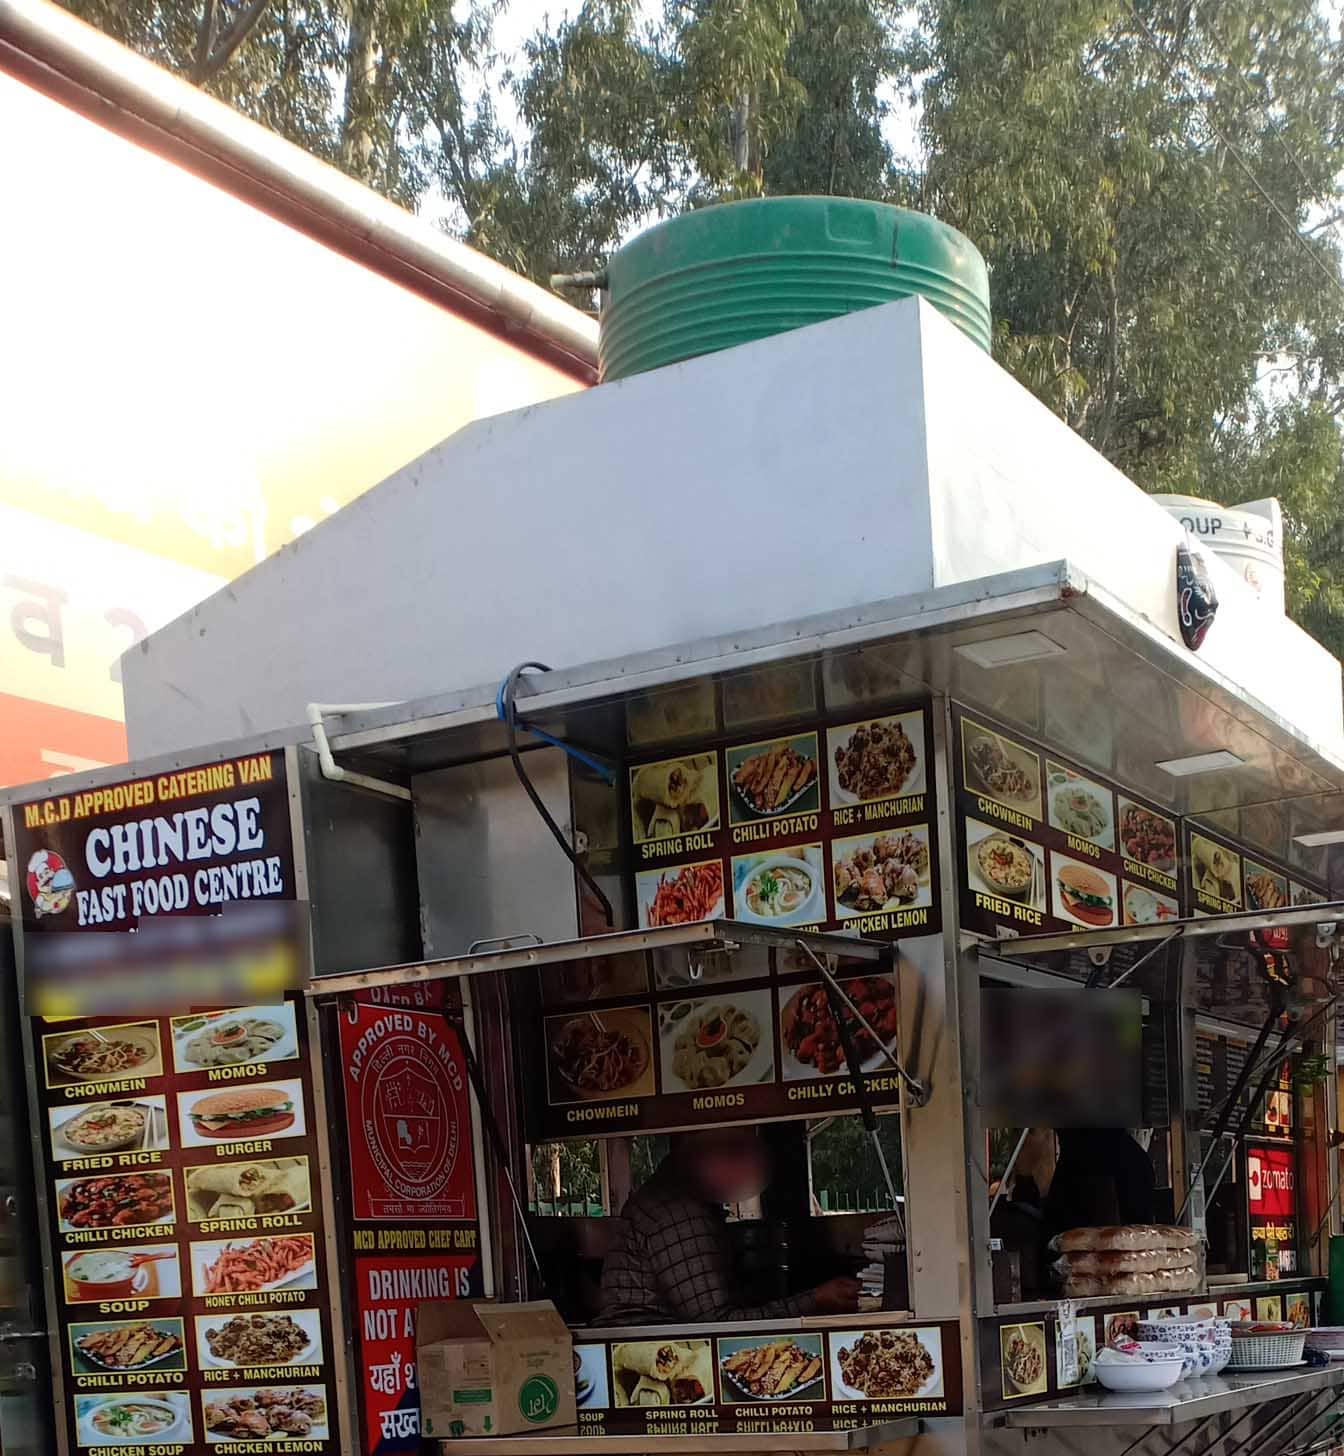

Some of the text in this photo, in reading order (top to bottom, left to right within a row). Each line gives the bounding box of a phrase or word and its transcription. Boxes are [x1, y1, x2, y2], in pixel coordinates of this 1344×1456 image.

[25, 756, 273, 828] M.C.D APPROVED CATERING VAN
[833, 807, 854, 826] RICE
[865, 796, 924, 820] MANCHURIAN
[977, 799, 1033, 832] CHOWMEIN
[85, 797, 264, 878] CHINESE
[733, 815, 818, 843] CHILLI POTATO
[642, 833, 714, 859] SPRING ROLL
[1067, 836, 1100, 859] MOMOS
[1123, 859, 1177, 891] CHILLI CHICKEN
[76, 856, 283, 926] FAST FOOD CENTRE
[891, 909, 928, 929] LEMON
[975, 893, 1041, 926] FRIED RICE
[349, 1015, 463, 1091] APPROVED BY MCD
[208, 1063, 267, 1082] MOMOS
[64, 1079, 146, 1099] CHOWMEIN
[788, 1077, 899, 1100] CHILLY CHCKEN
[693, 1093, 745, 1110] MOMOS
[567, 1104, 639, 1122] CHOWMEIN
[216, 1141, 272, 1157] BURGER
[365, 1119, 394, 1185] MUNICIPAL
[395, 1172, 446, 1198] CORPORATION
[62, 1152, 161, 1172] FRIED RICE
[1262, 1168, 1294, 1191] zomato
[65, 1224, 174, 1244] CHILLI CHICKEN
[199, 1214, 302, 1234] SPRING ROLL
[353, 1229, 476, 1250] MCD APPROVED CHEF CART
[369, 1267, 470, 1300] DRINKING IS
[99, 1300, 150, 1314] SOUP
[205, 1291, 305, 1308] HONEY CHILLI POTATO
[363, 1308, 398, 1340] NOT
[77, 1372, 184, 1387] CHILLI POTATO
[203, 1370, 230, 1382] RICE
[244, 1366, 320, 1380] MANCHURIAN
[579, 1412, 604, 1423] SOUP
[646, 1408, 718, 1420] SPRING ROLL
[735, 1406, 813, 1417] CHILLI POTATO
[831, 1404, 857, 1414] RICE
[871, 1401, 947, 1413] MANCHURIAN
[149, 1445, 184, 1456] SOUP
[214, 1441, 323, 1455] CHICKEN LEMON
